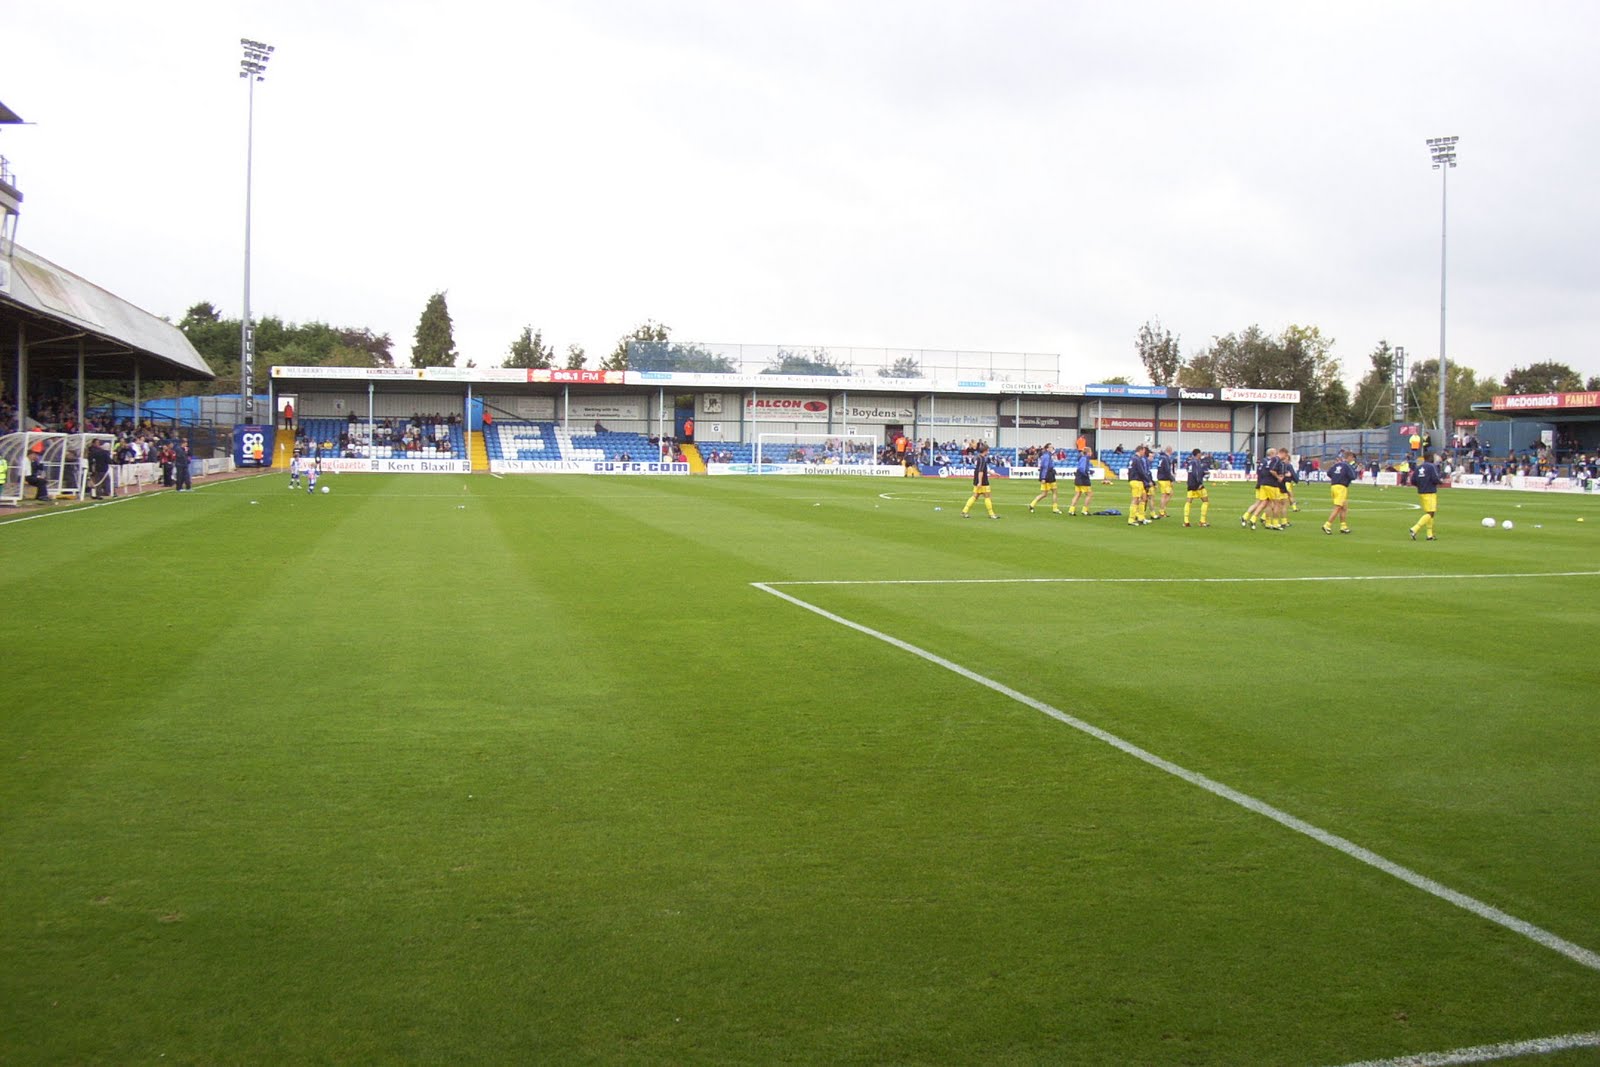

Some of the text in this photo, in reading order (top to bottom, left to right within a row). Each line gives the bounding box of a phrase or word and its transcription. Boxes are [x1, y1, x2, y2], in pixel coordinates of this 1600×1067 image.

[554, 372, 578, 380] 96.1
[581, 373, 599, 381] FM
[1269, 392, 1297, 400] ESTATES
[1506, 394, 1598, 407] McDonald's FAMILY
[747, 400, 802, 408] FALCON
[852, 408, 896, 419] Boydens
[1186, 422, 1229, 430] ENCLOSURE
[388, 462, 455, 471] Kent Blaxill
